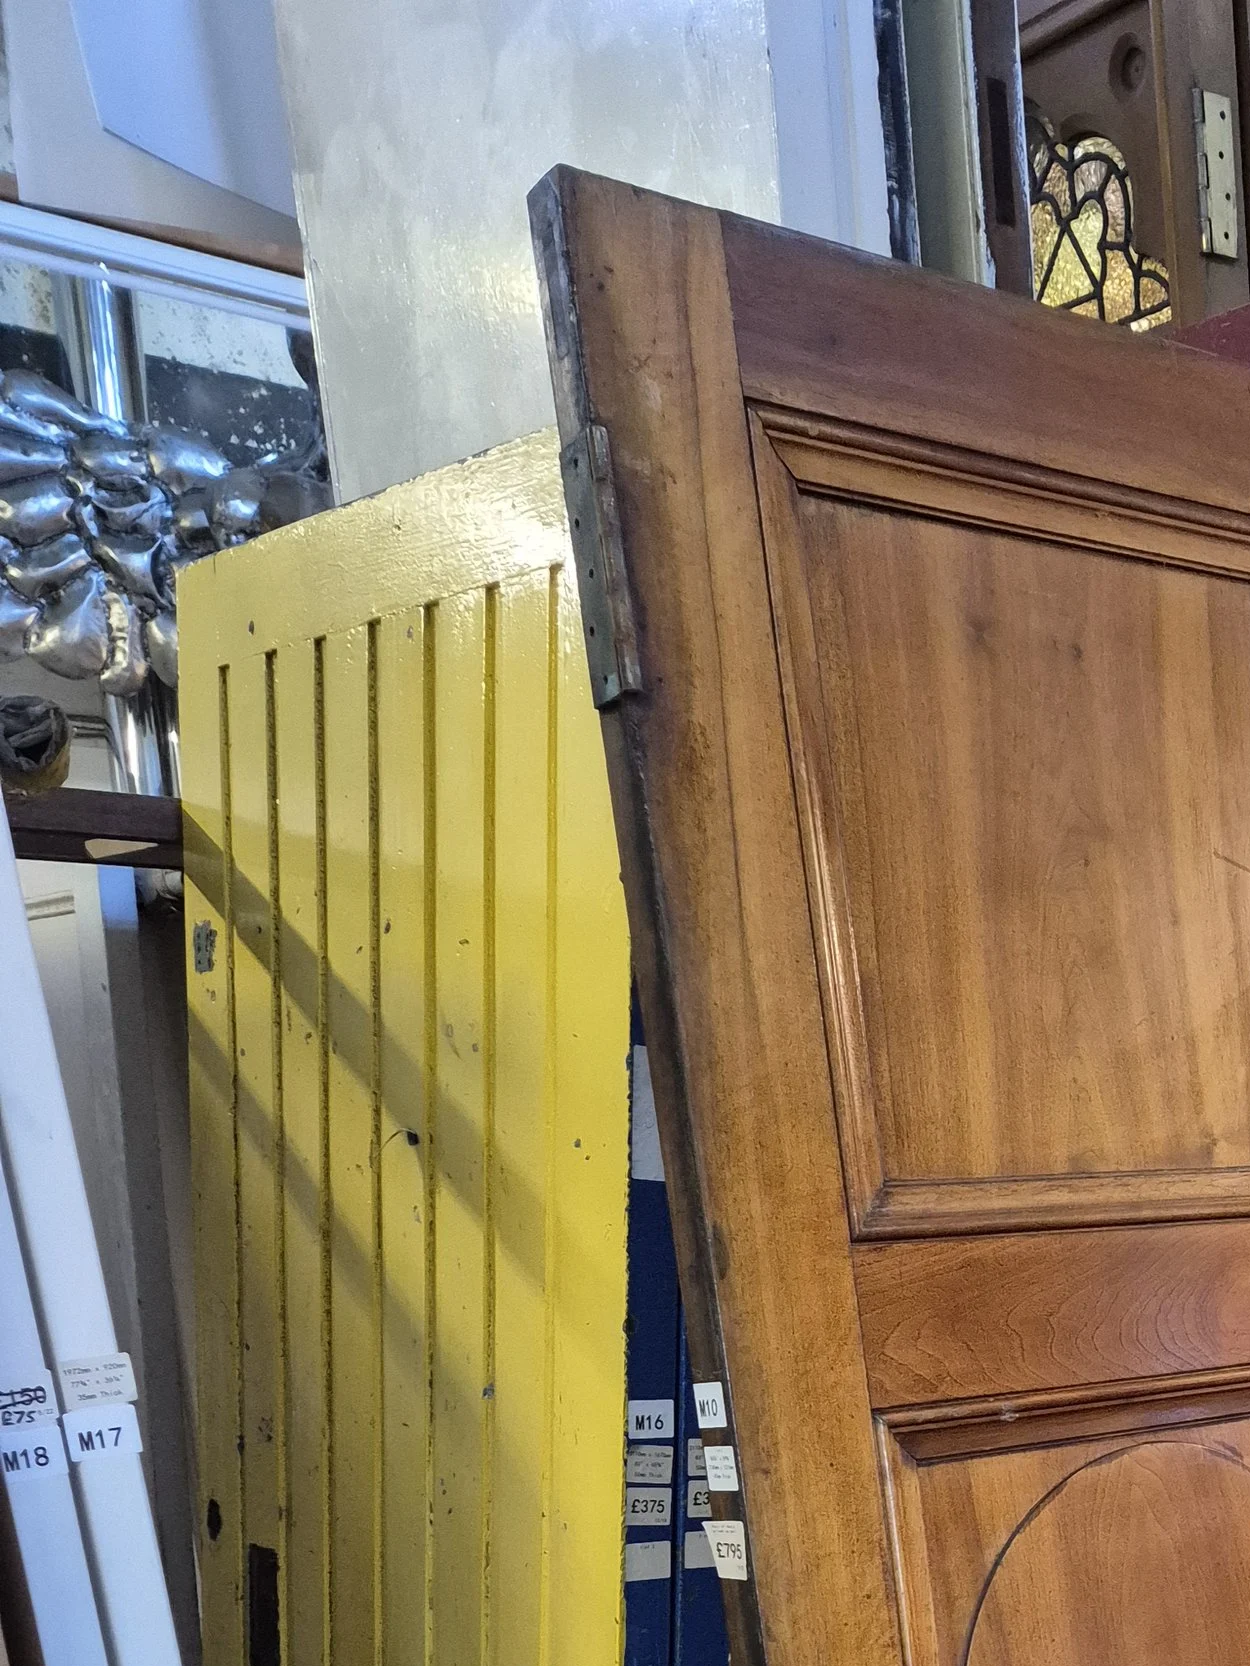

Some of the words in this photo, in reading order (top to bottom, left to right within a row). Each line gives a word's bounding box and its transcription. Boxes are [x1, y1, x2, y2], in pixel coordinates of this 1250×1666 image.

[698, 1398, 718, 1417] M10
[1, 1410, 36, 1427] £75
[635, 1414, 664, 1431] M16
[78, 1427, 122, 1452] M17
[2, 1446, 49, 1472] M18
[631, 1498, 665, 1514] £375
[716, 1541, 743, 1560] £795
